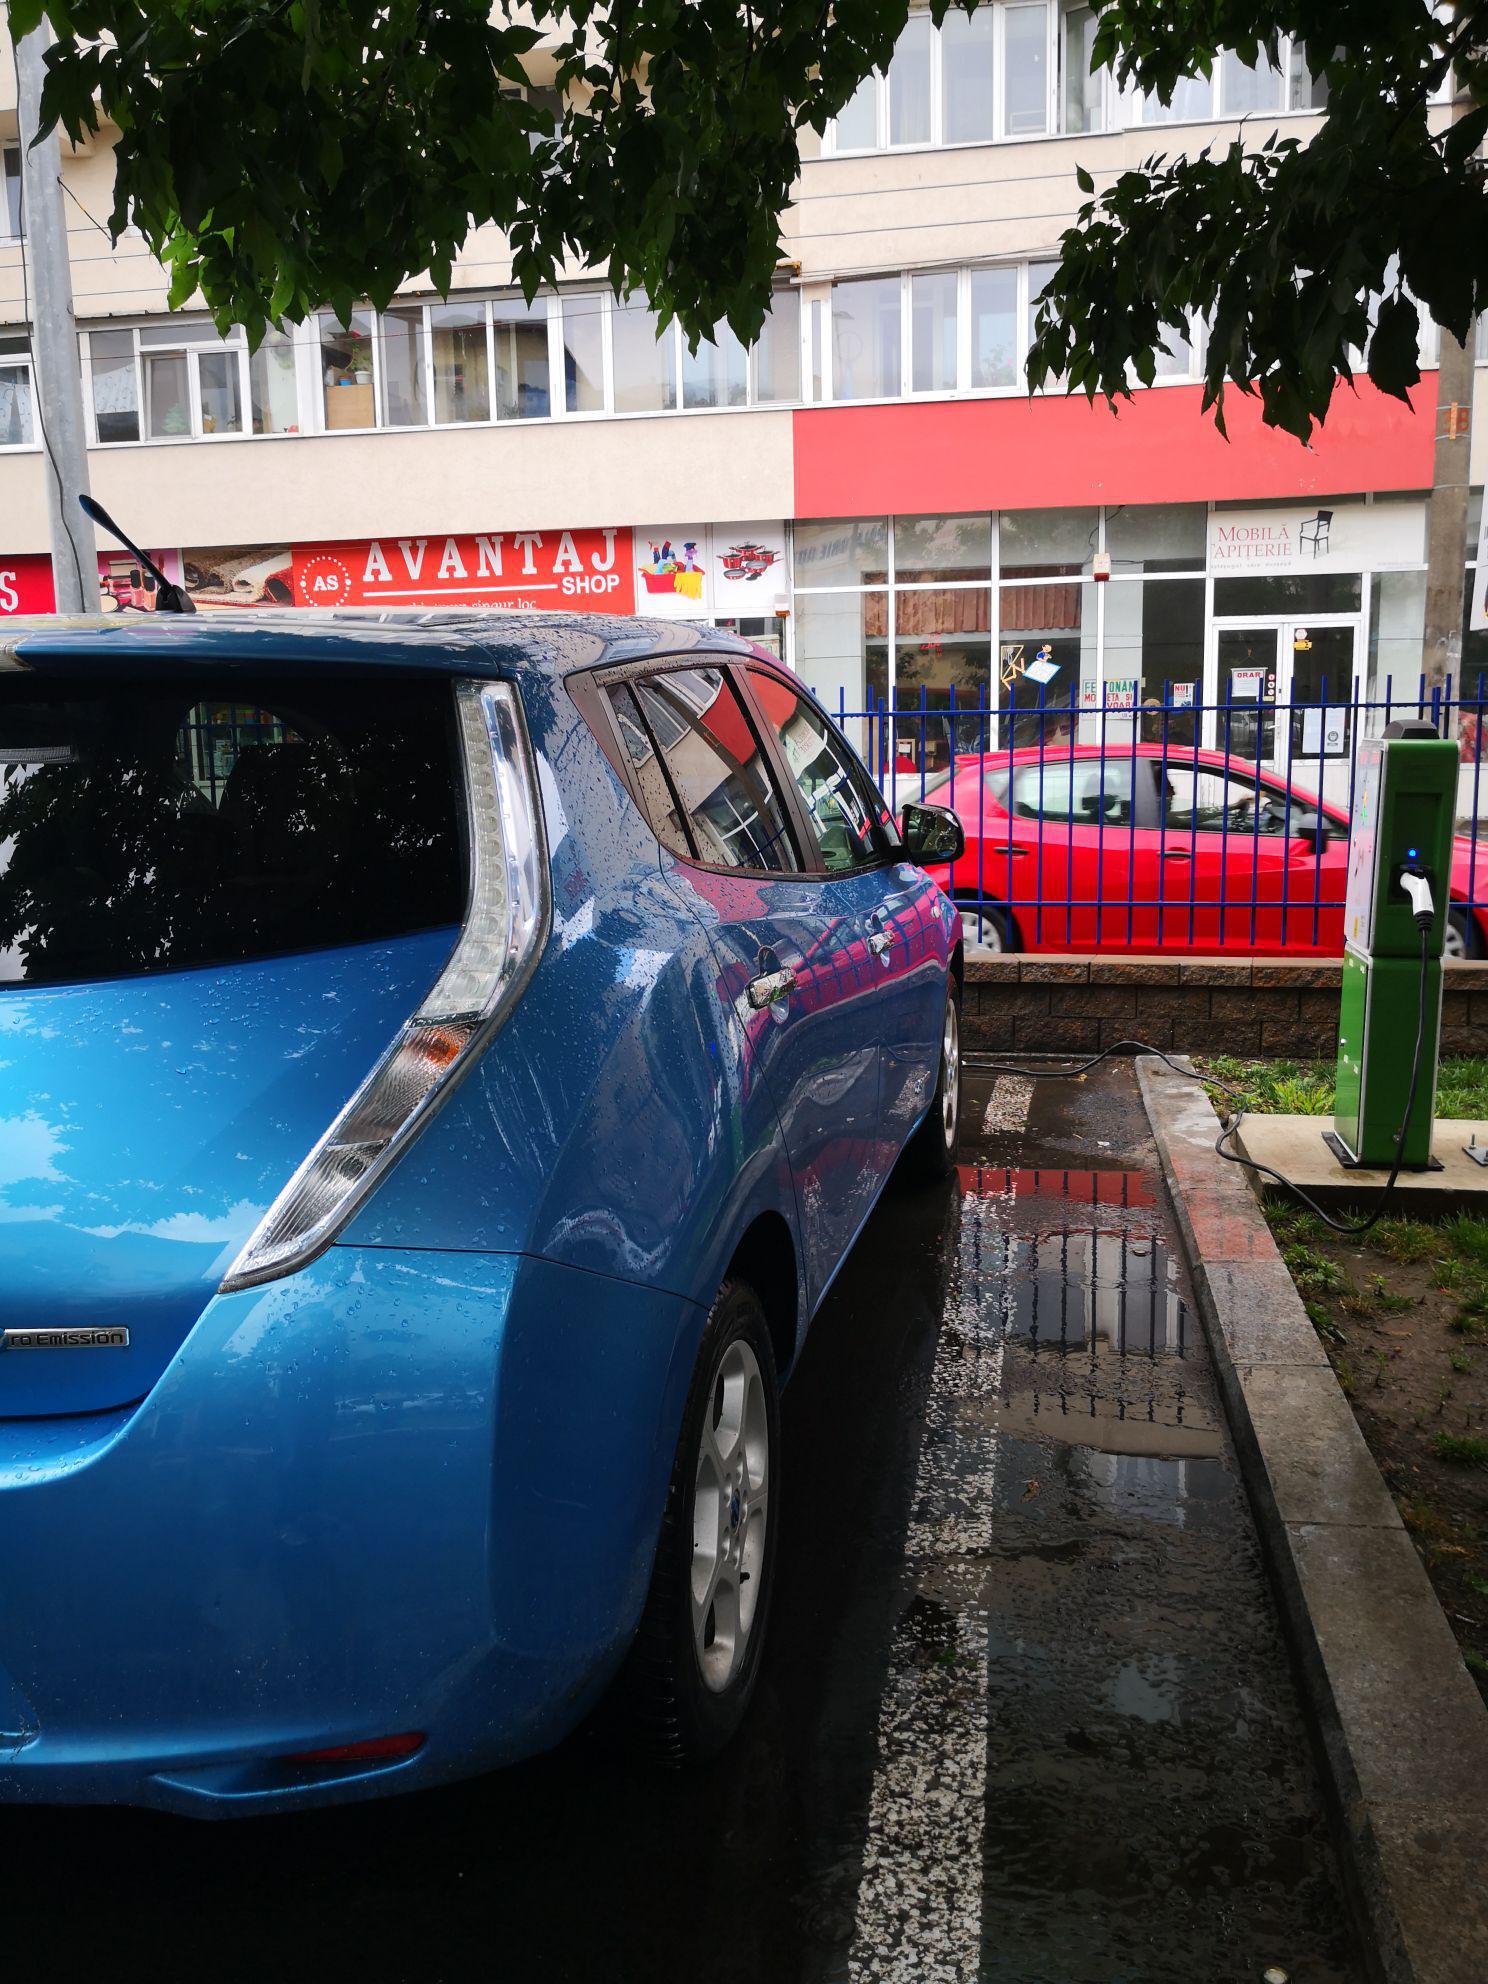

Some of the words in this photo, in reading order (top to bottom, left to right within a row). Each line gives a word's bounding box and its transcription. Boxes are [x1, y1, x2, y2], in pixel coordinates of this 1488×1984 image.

[1218, 523, 1289, 541] MOBILĂ
[363, 528, 617, 582] AVANTAJ
[313, 575, 339, 592] AS
[562, 574, 620, 595] SHOP
[1084, 693, 1119, 702] MOETA
[36, 1331, 124, 1346] Emission
